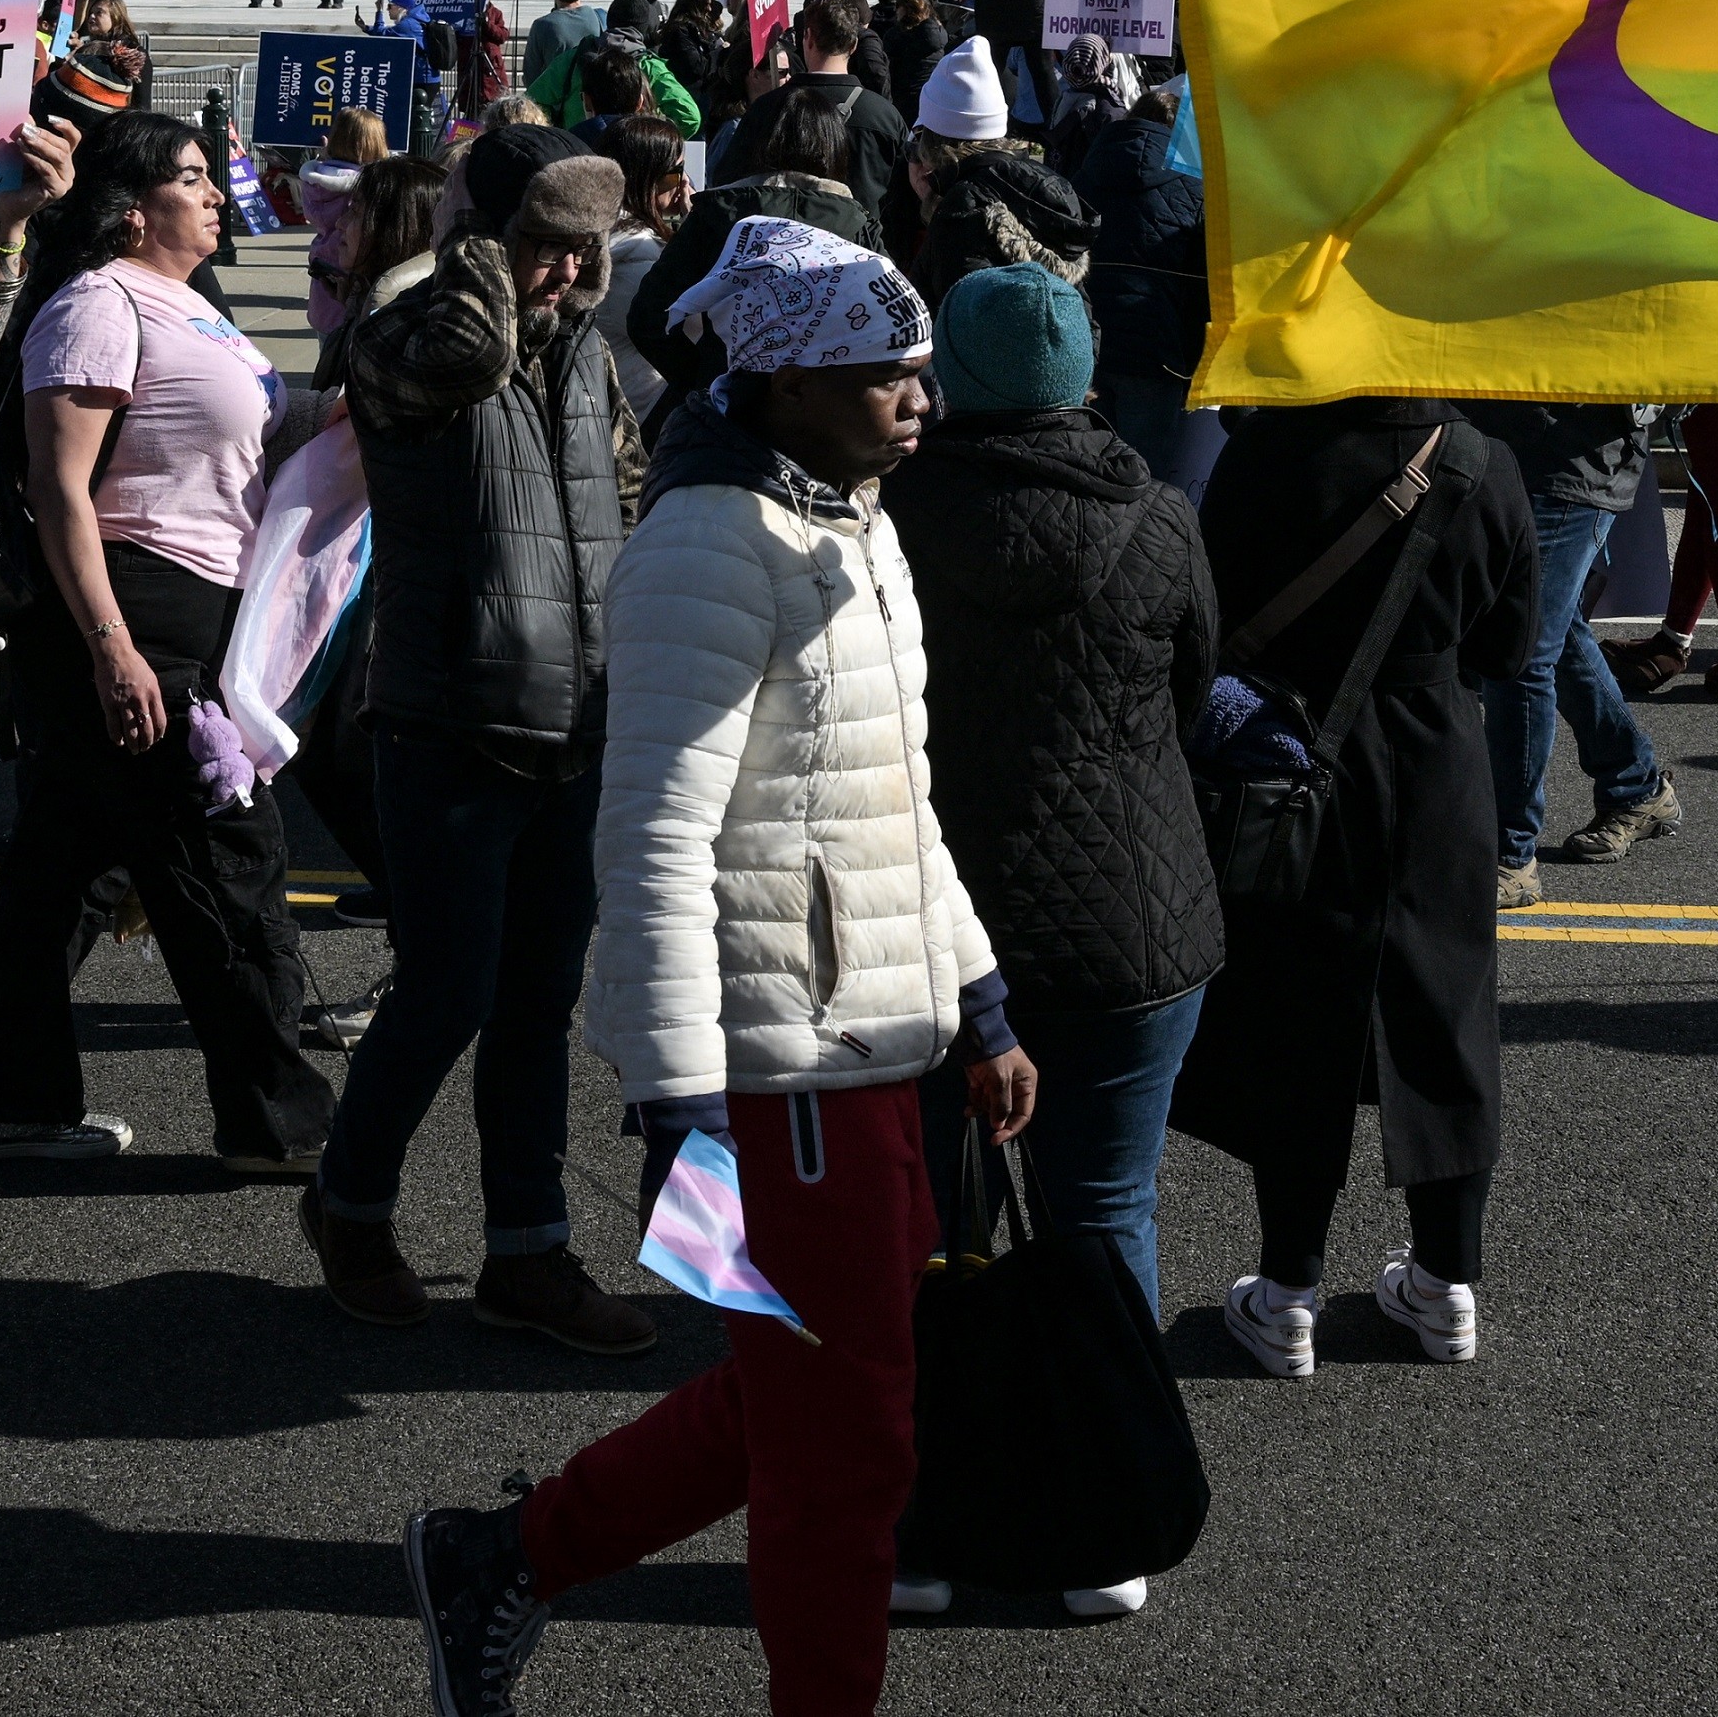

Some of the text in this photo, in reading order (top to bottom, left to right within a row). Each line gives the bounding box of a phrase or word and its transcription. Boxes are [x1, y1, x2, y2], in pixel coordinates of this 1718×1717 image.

[435, 5, 463, 13] FEMALE.
[1049, 15, 1166, 40] HORMONE LEVEL
[290, 62, 302, 96] MOMS
[341, 49, 356, 103] to those
[379, 61, 391, 86] The
[277, 62, 292, 118] LIBERTY
[312, 56, 337, 127] VOTE
[1449, 1316, 1466, 1324] NIKE
[1287, 1331, 1305, 1339] NIKE
